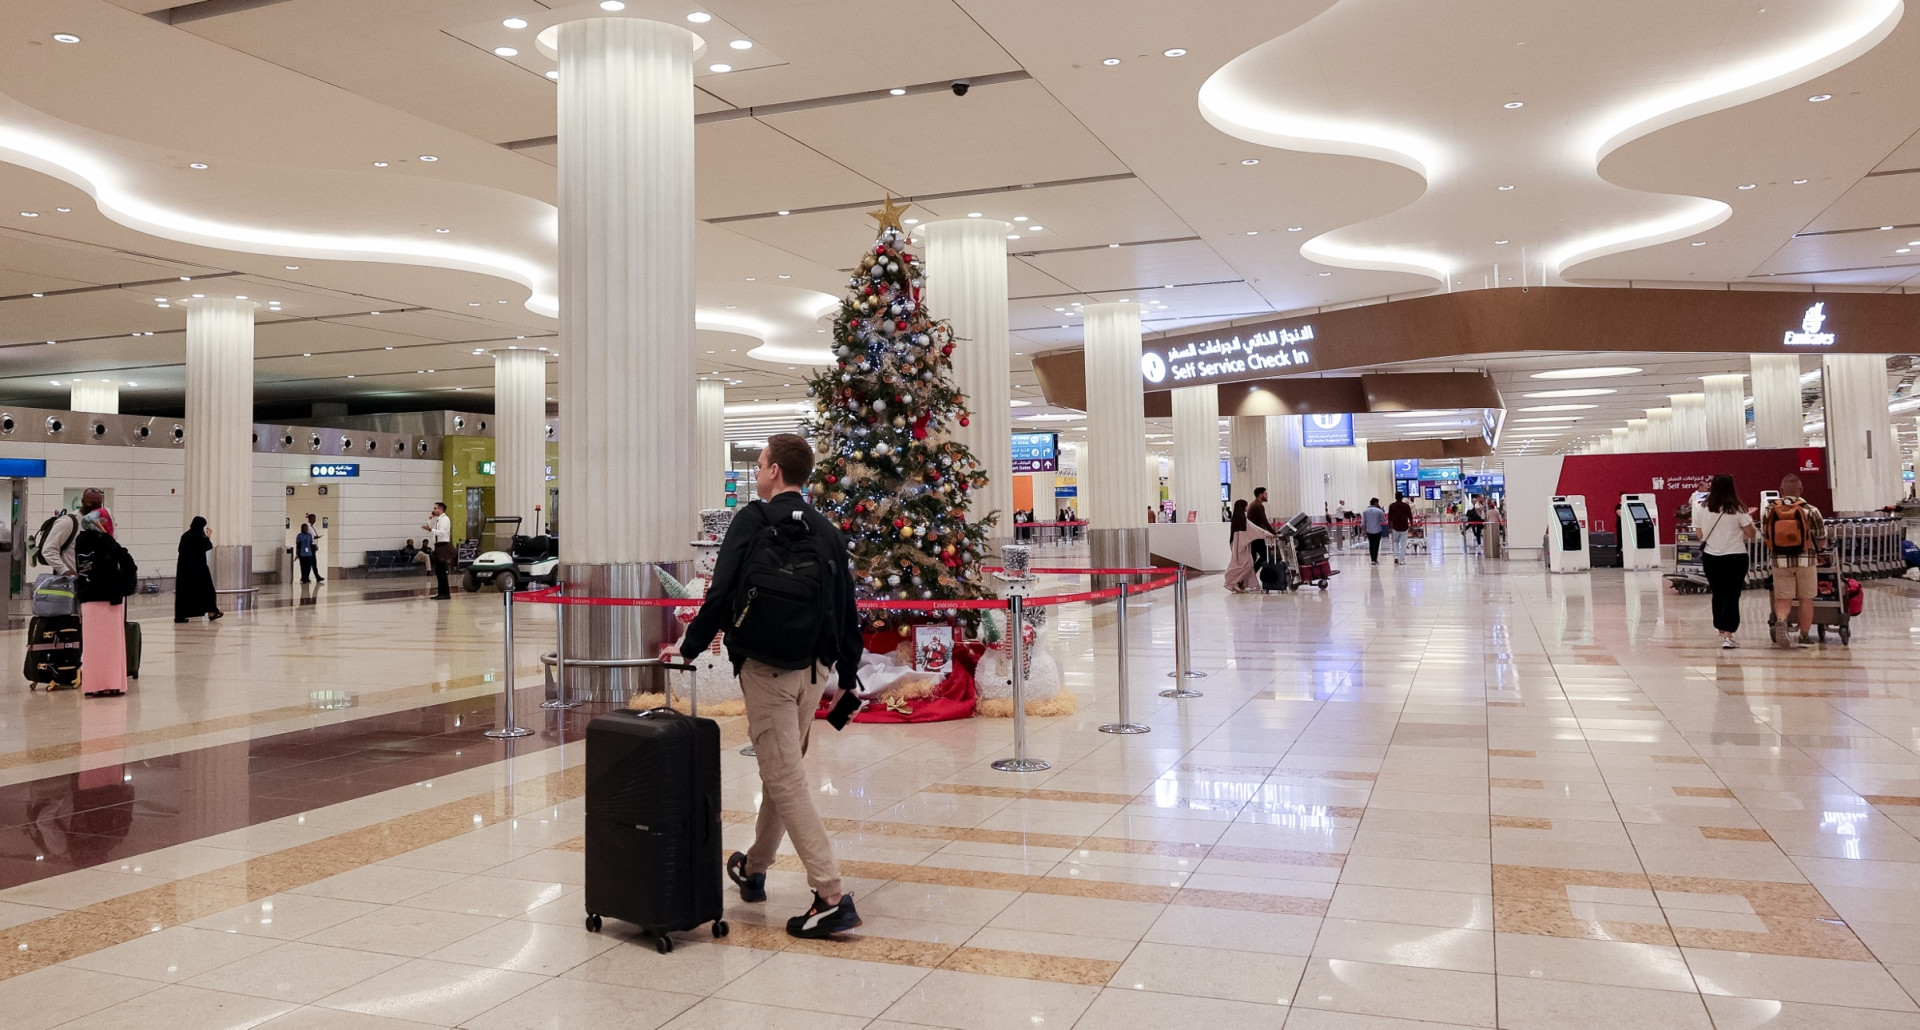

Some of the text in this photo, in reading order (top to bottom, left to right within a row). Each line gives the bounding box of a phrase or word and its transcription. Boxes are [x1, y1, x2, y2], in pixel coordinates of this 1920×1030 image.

[1783, 331, 1835, 345] Emirates
[1171, 348, 1309, 380] Self Service Check In
[1402, 459, 1412, 471] 3
[1667, 482, 1680, 490] Self
